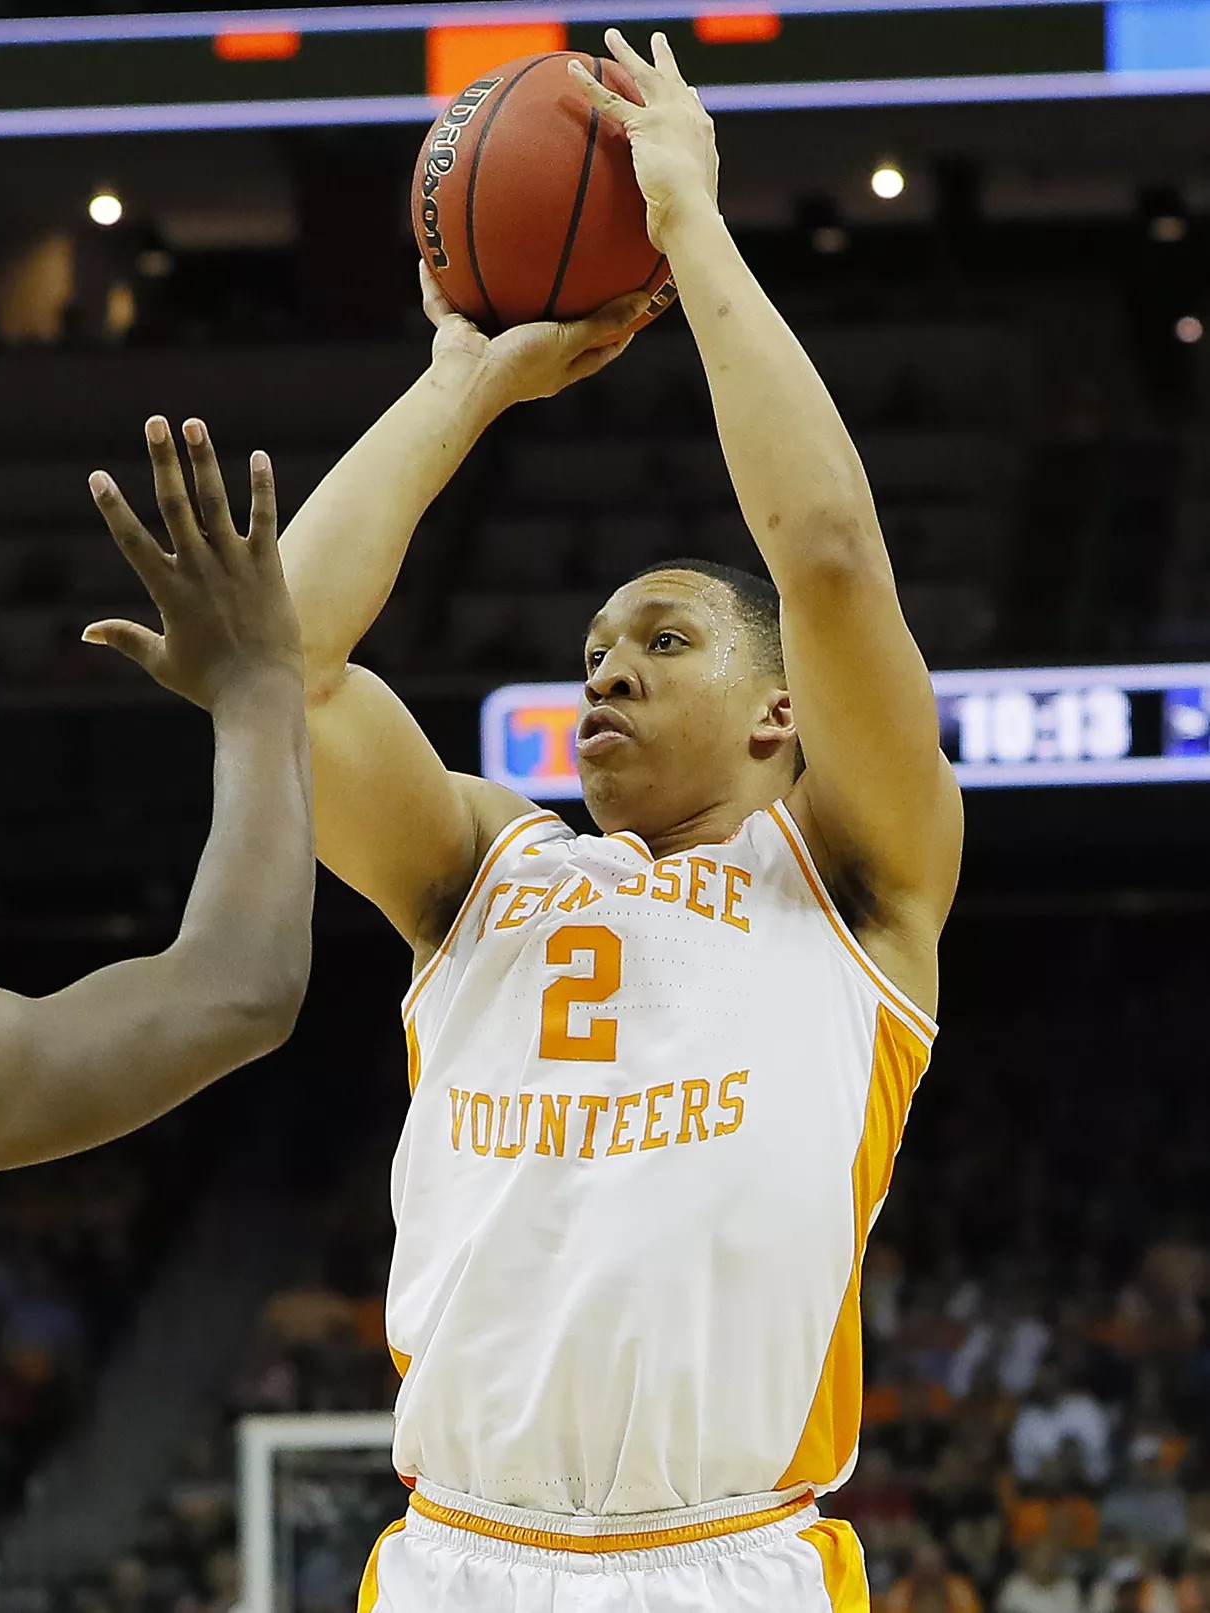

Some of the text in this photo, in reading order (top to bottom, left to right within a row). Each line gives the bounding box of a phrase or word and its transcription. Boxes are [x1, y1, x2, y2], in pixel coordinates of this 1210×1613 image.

[421, 76, 504, 269] Wilson
[539, 926, 622, 1062] 2
[449, 1070, 750, 1159] VOLUNTEERS
